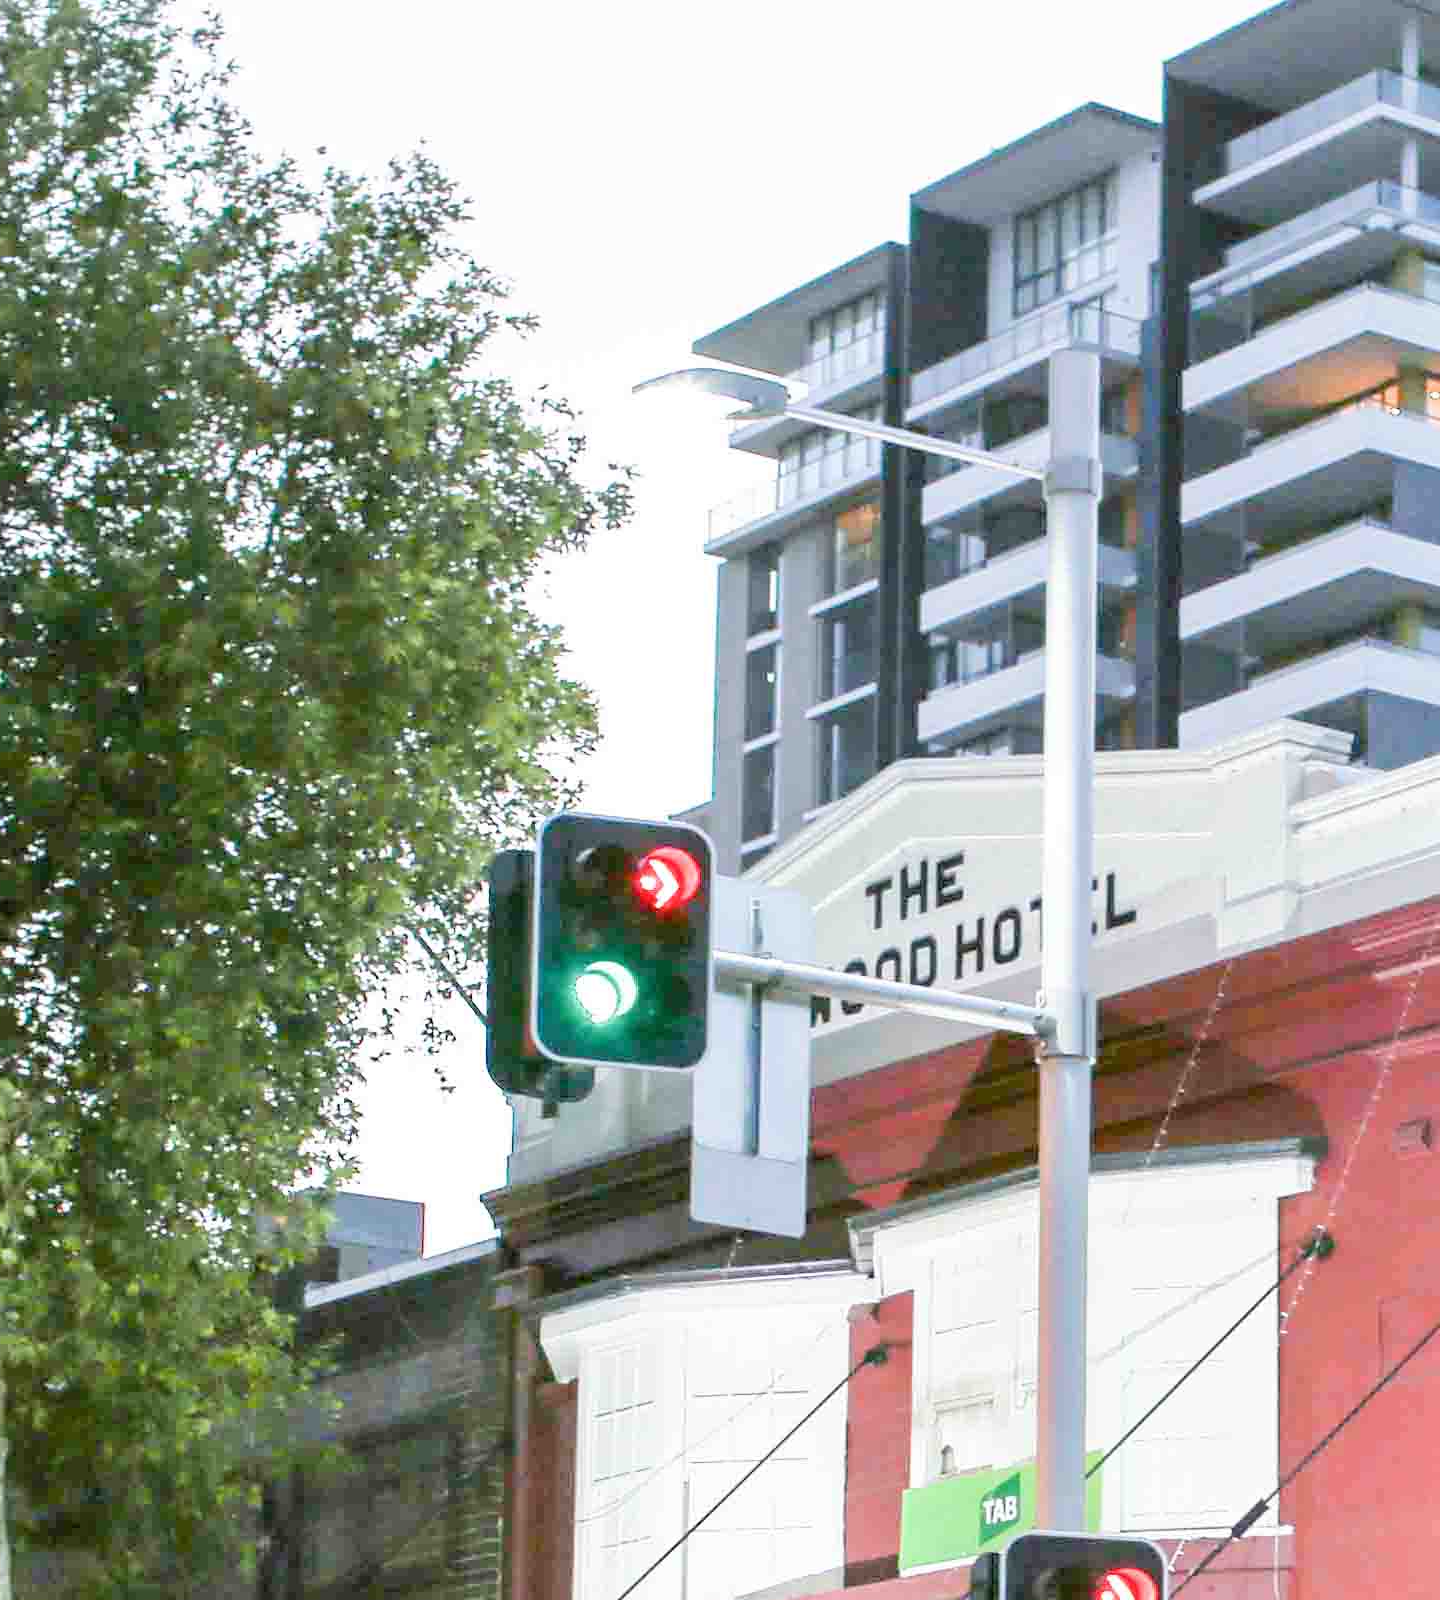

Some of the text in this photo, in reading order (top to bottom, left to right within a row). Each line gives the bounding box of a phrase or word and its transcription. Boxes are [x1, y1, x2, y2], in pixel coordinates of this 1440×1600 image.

[865, 851, 965, 929] THE
[955, 872, 1137, 981] HOL
[981, 1495, 1018, 1525] TAB
